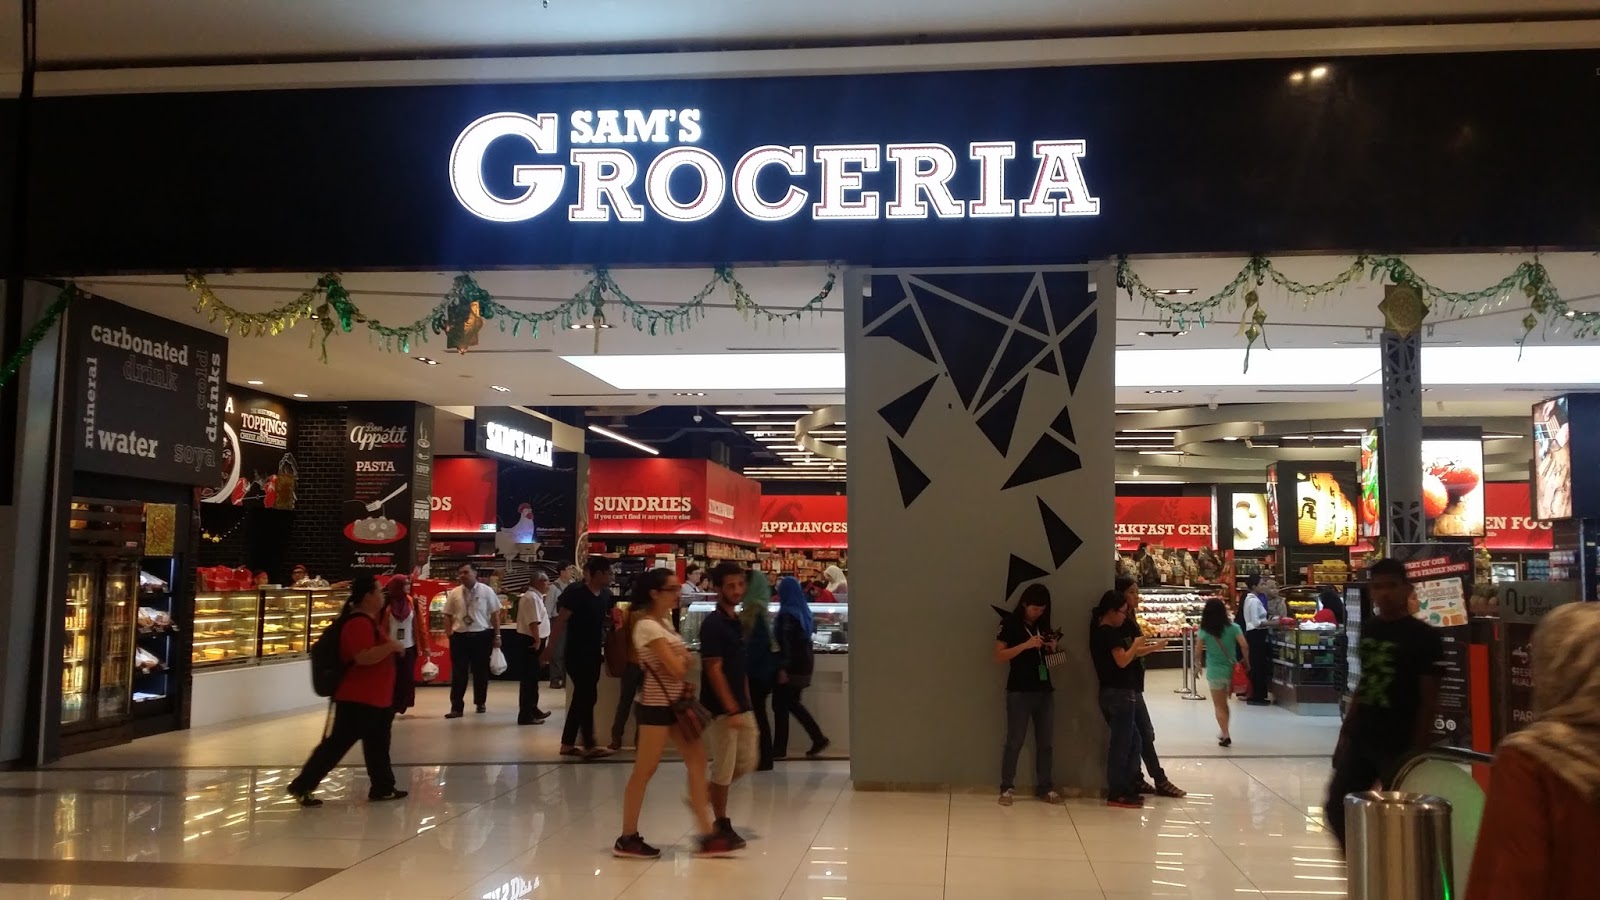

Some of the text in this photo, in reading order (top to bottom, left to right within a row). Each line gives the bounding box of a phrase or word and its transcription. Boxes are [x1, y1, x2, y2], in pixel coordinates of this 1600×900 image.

[570, 108, 702, 143] SAM'S
[449, 111, 1101, 222] GROCERIA
[91, 324, 189, 366] carbonated
[123, 354, 179, 391] drink
[195, 350, 208, 410] cold
[84, 357, 98, 448] mineral
[206, 353, 220, 443] drinks
[241, 412, 288, 436] TOPPINGS
[366, 421, 383, 432] Bon
[98, 429, 158, 459] water
[174, 444, 216, 472] soya
[523, 433, 553, 467] DELI
[355, 461, 396, 472] PASTA
[593, 496, 692, 512] SUNDRIES
[647, 513, 678, 521] anywhere
[760, 521, 848, 533] APPLIANCES
[1177, 524, 1212, 536] CER
